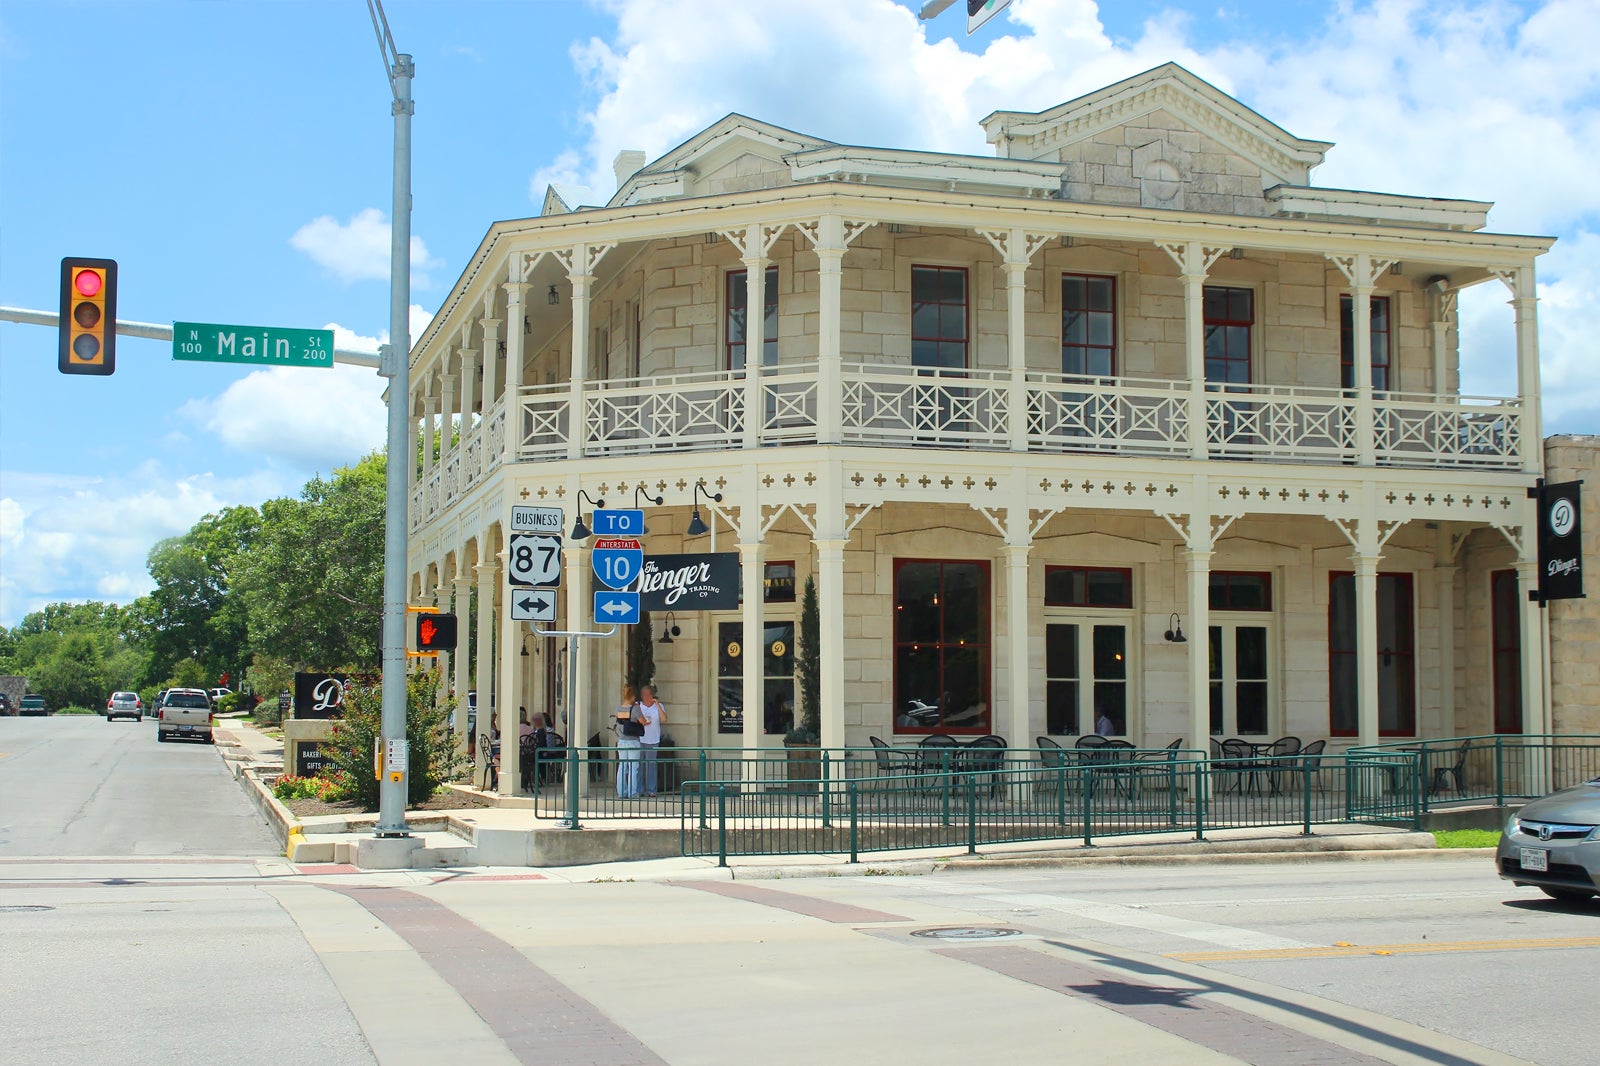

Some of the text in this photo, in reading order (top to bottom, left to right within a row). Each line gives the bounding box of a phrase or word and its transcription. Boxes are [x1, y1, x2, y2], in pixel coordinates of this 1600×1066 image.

[181, 342, 202, 354] 100
[190, 330, 321, 359] N Main St
[303, 349, 327, 361] 200
[516, 512, 558, 526] BUSINESS
[606, 515, 631, 530] TO
[600, 541, 635, 549] INTERSTATE
[515, 545, 556, 573] 87
[604, 556, 630, 580] 10
[644, 560, 659, 574] The
[689, 585, 720, 594] TRADING
[306, 762, 322, 770] GIFTS
